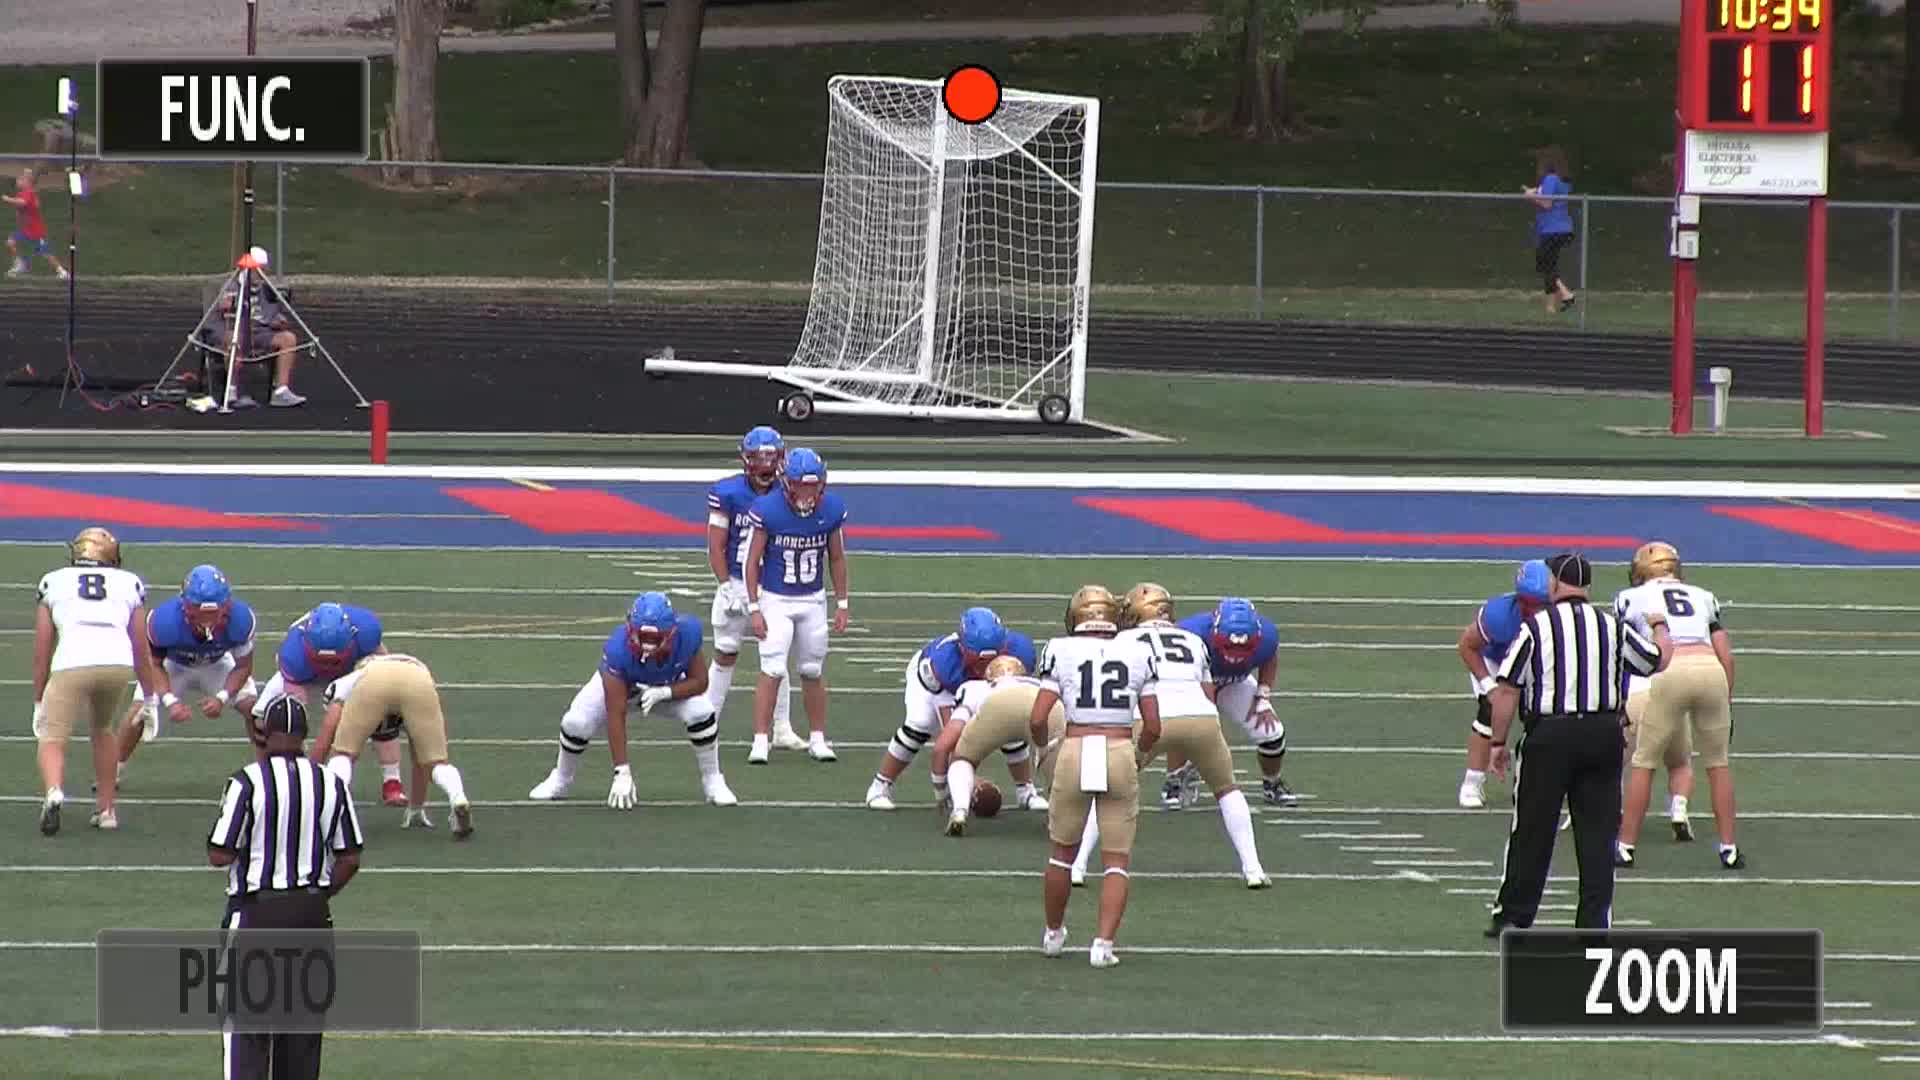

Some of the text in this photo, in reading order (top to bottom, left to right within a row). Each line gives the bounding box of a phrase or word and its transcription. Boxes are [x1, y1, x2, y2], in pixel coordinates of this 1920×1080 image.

[783, 549, 819, 584] 10
[78, 573, 107, 601] 8
[1663, 589, 1696, 617] 6
[1076, 660, 1130, 709] 12
